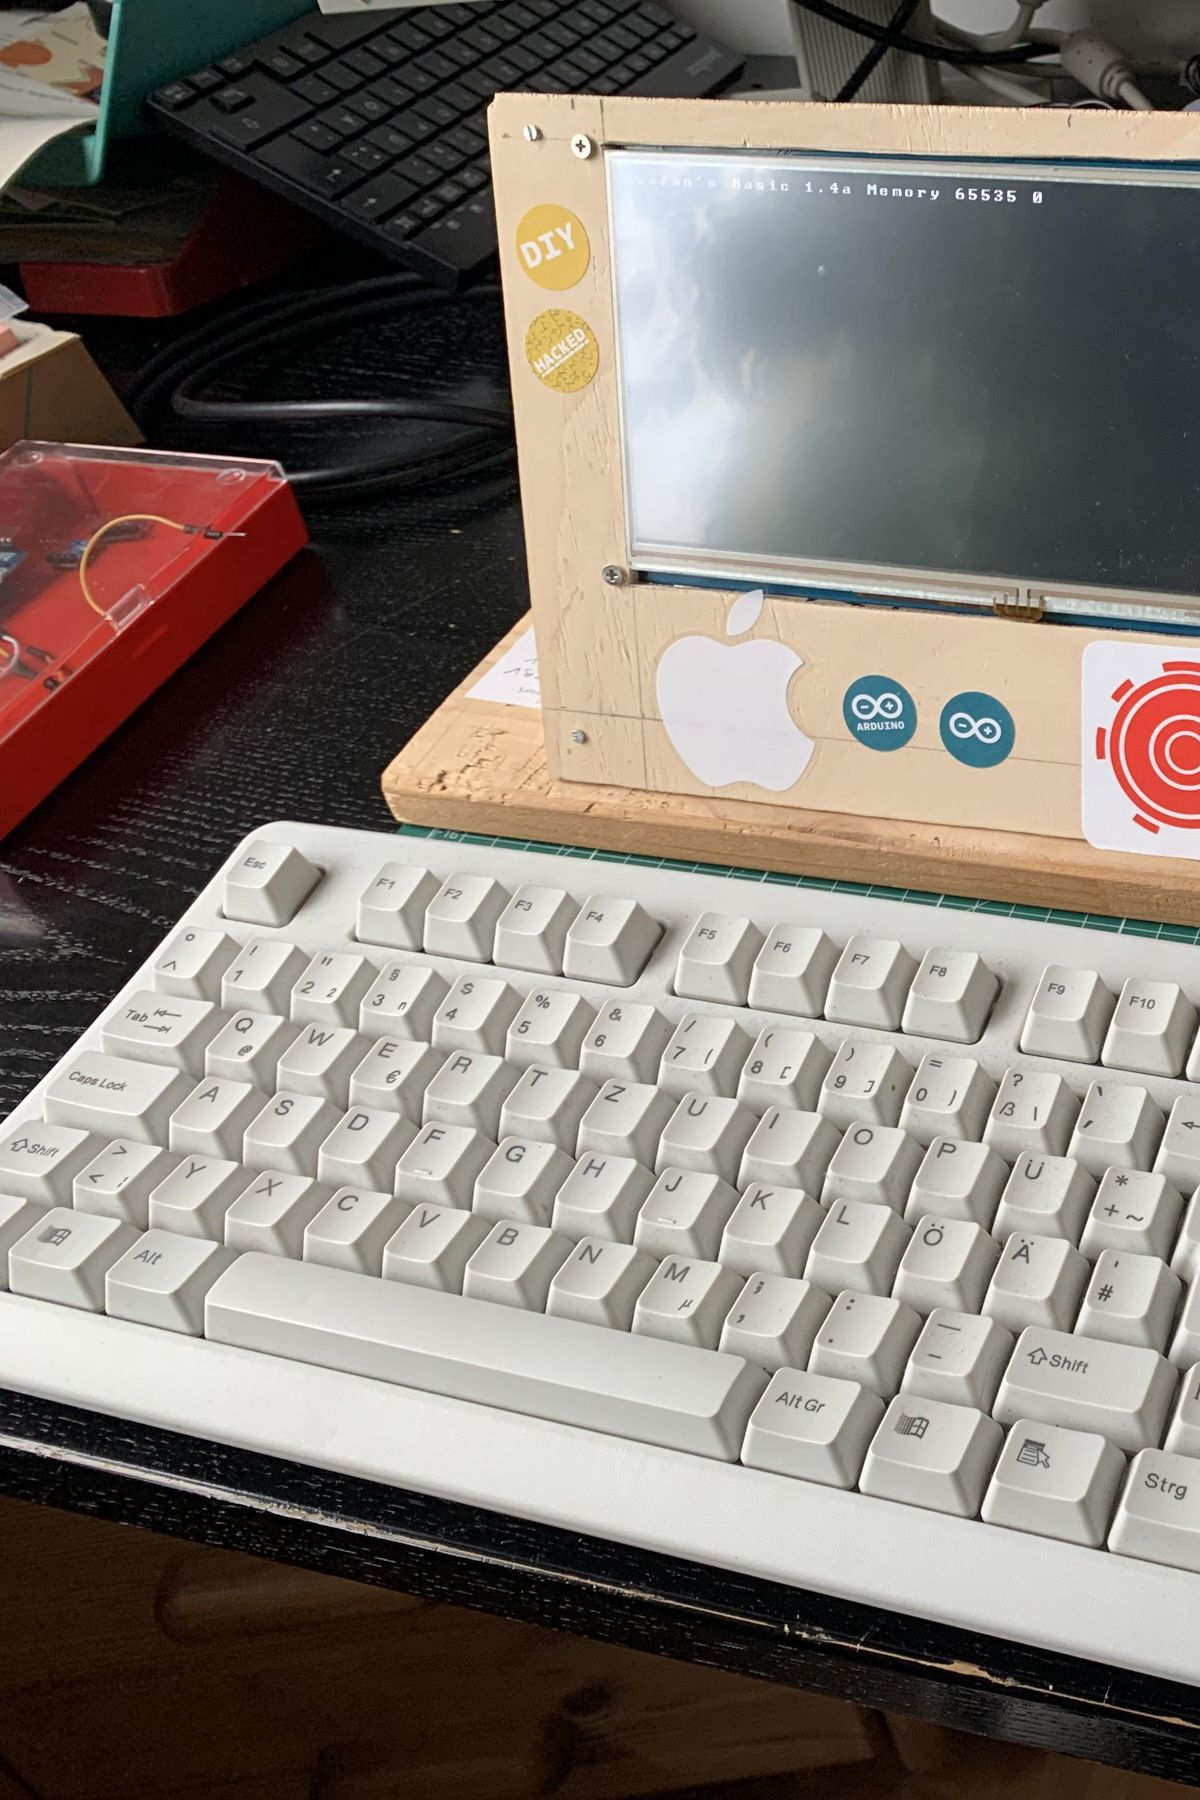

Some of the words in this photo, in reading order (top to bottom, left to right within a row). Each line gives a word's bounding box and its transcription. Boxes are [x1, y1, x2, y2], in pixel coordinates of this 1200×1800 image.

[732, 177, 790, 192] Basic
[804, 180, 851, 194] 1.4a
[866, 183, 940, 200] Memory
[954, 187, 1017, 203] 65535
[520, 222, 576, 269] DIY
[534, 328, 587, 375] HACKED
[857, 721, 905, 731] ARDUINO
[243, 856, 267, 870] Esc
[375, 877, 396, 890] F1
[442, 887, 463, 900] F2
[514, 899, 533, 912] F3
[585, 910, 604, 923] F4
[697, 927, 718, 941] F5
[773, 940, 792, 953] F6
[850, 953, 871, 965] F7
[233, 969, 244, 982] 1
[929, 964, 948, 978] F8
[299, 980, 316, 995] 2
[1047, 982, 1066, 996] F9
[371, 993, 386, 1007] 3
[1128, 995, 1156, 1010] F10
[125, 1009, 149, 1023] Tab
[444, 1007, 459, 1021] 4
[234, 1017, 254, 1034] Q
[517, 1020, 532, 1035] 5
[307, 1028, 335, 1047] W
[594, 1034, 607, 1048] 6
[376, 1041, 399, 1059] E
[672, 1045, 687, 1060] 7
[450, 1055, 473, 1074] R
[750, 1060, 764, 1075] 8
[68, 1071, 100, 1086] Caps
[98, 1078, 128, 1092] Lock
[529, 1068, 549, 1087] T
[833, 1074, 847, 1089] 9
[198, 1086, 220, 1103] A
[603, 1084, 627, 1103] Z
[274, 1099, 295, 1116] S
[687, 1098, 709, 1117] U
[998, 1101, 1016, 1117] ß
[346, 1113, 370, 1132] D
[422, 1128, 447, 1145] F
[26, 1143, 60, 1158] Shift
[505, 1145, 527, 1164] G
[936, 1141, 957, 1159] P
[185, 1161, 208, 1179] Y
[582, 1158, 607, 1179] H
[1024, 1159, 1045, 1181] Ü
[255, 1178, 283, 1197] X
[664, 1175, 683, 1193] J
[337, 1194, 359, 1212] C
[749, 1189, 774, 1211] K
[419, 1209, 441, 1229] V
[835, 1205, 850, 1226] L
[495, 1227, 520, 1246] B
[922, 1223, 945, 1247] Ö
[133, 1249, 163, 1266] Alt
[578, 1244, 604, 1265] N
[1011, 1238, 1035, 1265] Ä
[663, 1262, 691, 1283] M
[1048, 1354, 1089, 1375] Shift
[775, 1391, 803, 1409] Alt
[804, 1398, 826, 1413] Gr
[1144, 1472, 1188, 1501] Strg
